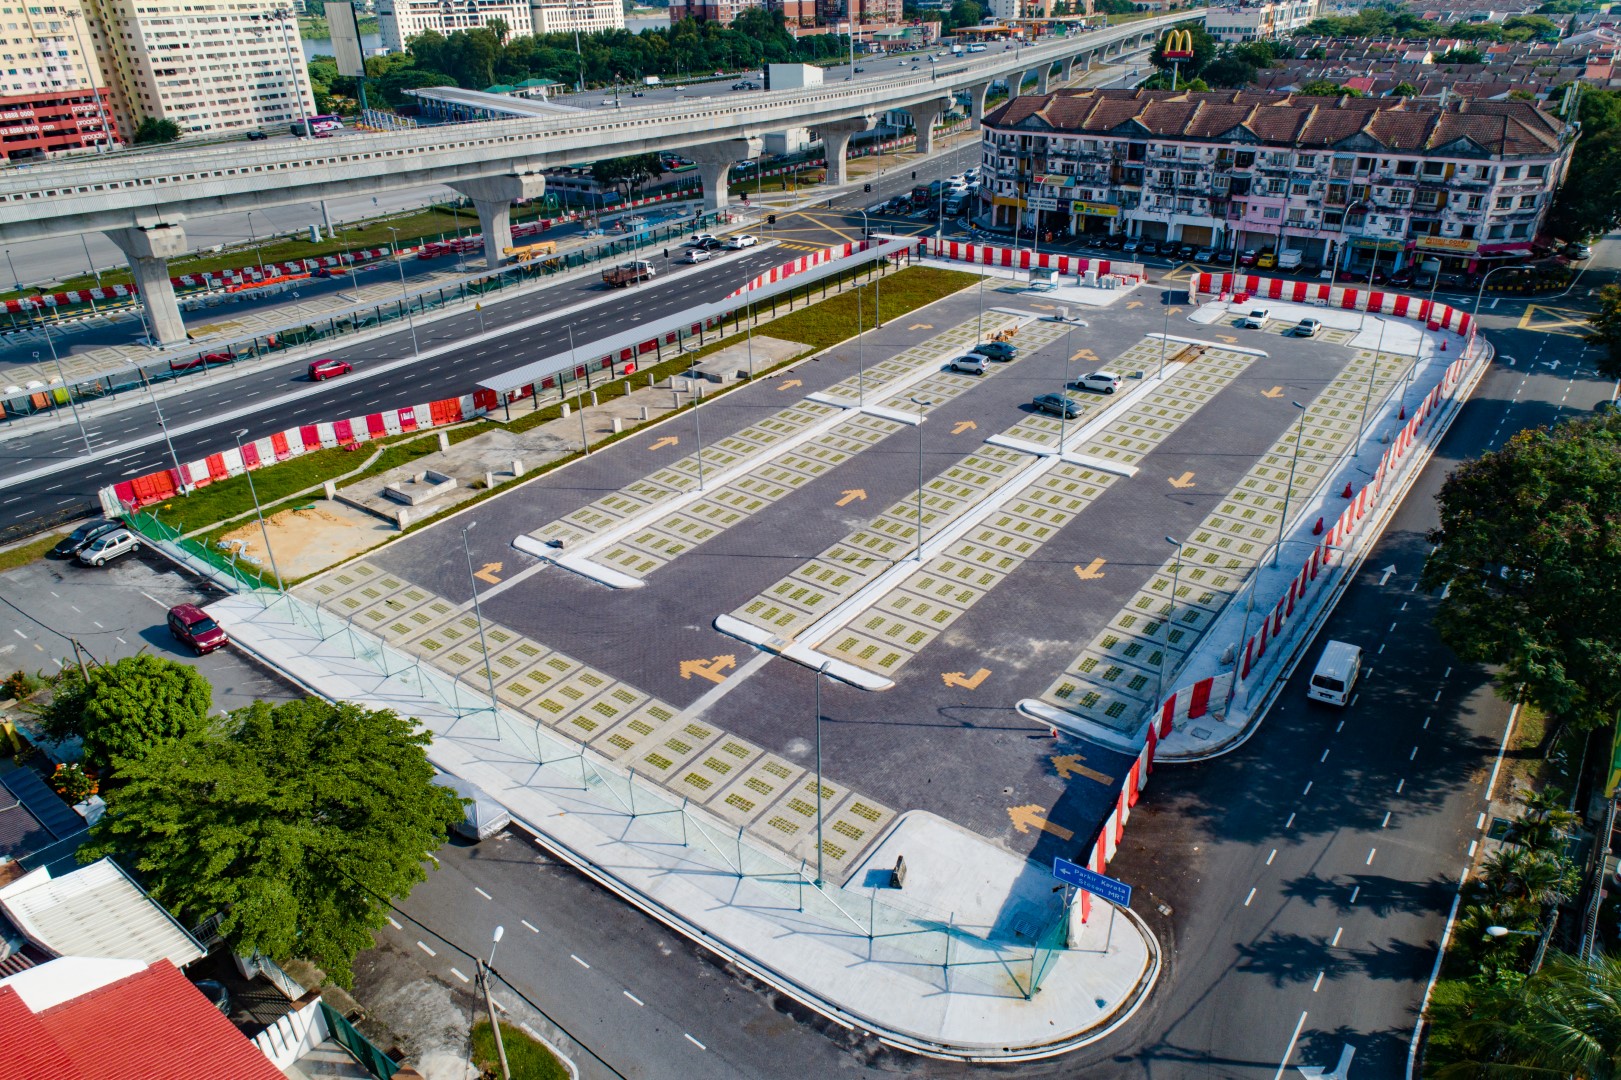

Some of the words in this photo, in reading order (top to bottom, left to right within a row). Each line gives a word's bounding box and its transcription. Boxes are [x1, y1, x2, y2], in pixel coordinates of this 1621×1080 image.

[1074, 869, 1097, 882] Parkir
[1101, 880, 1126, 894] Kereta
[1078, 878, 1104, 893] Stesen
[1108, 890, 1125, 901] MRT
